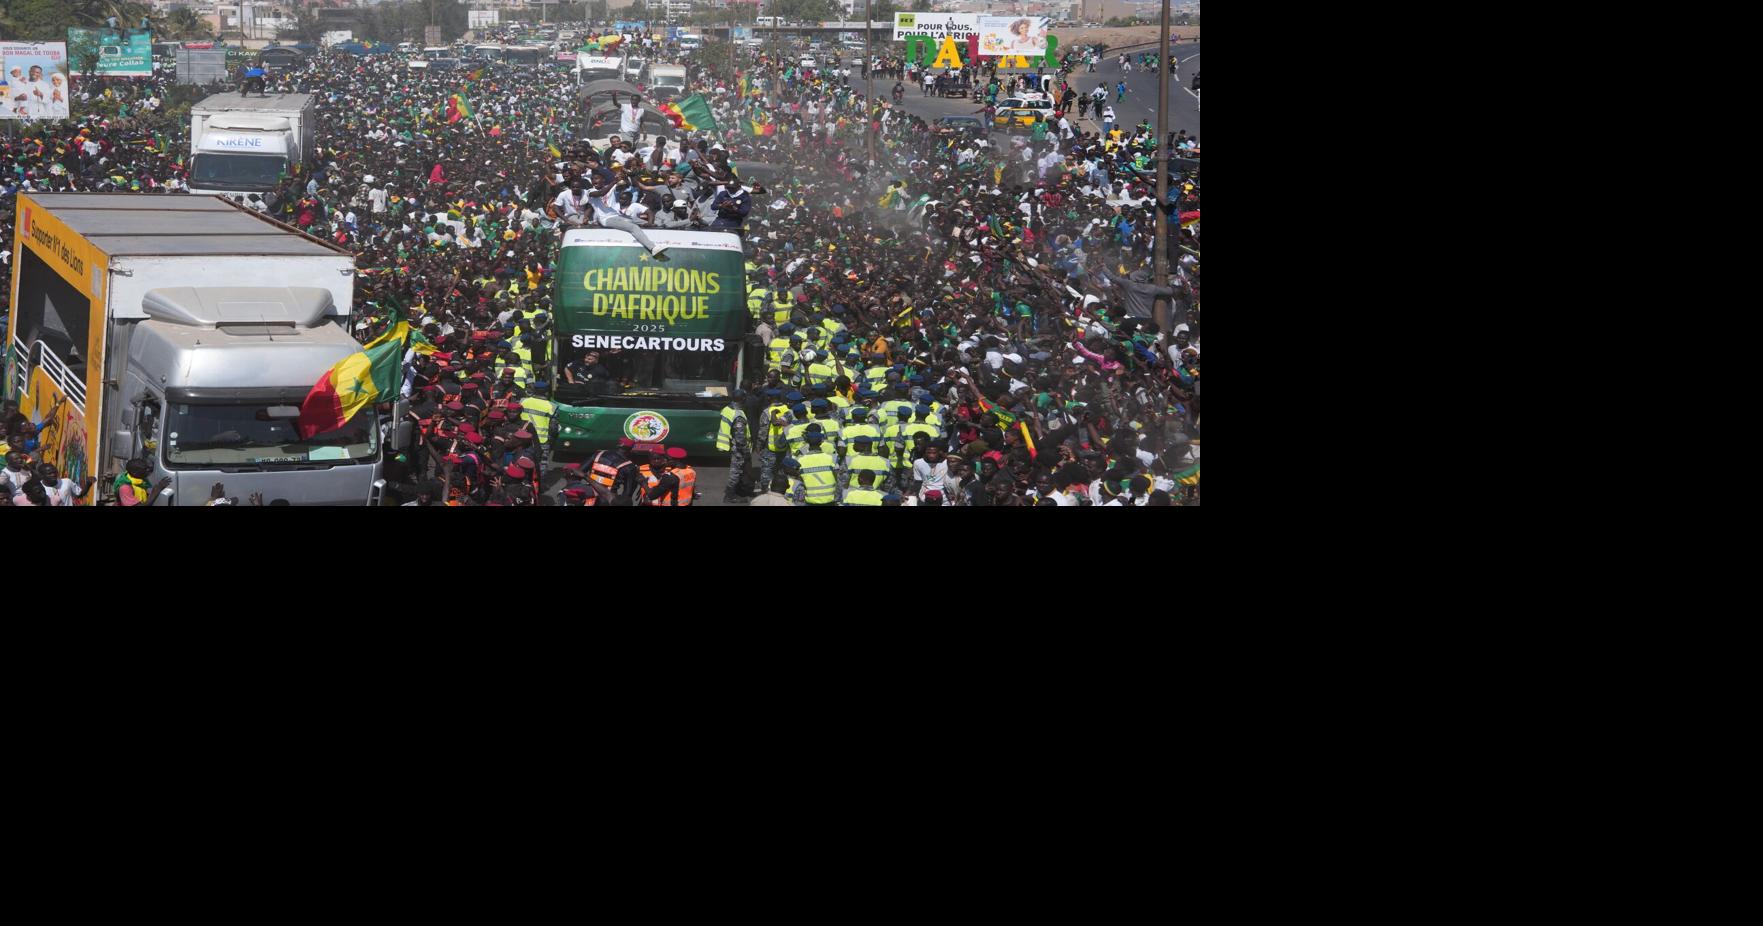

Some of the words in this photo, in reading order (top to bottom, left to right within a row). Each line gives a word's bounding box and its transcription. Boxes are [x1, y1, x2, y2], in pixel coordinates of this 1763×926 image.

[917, 23, 943, 31] POUR
[945, 23, 973, 31] VOUS,
[31, 219, 53, 250] Supporter
[61, 241, 70, 265] des
[69, 247, 84, 277] Lions
[583, 266, 720, 294] CHAMPIONS
[592, 293, 710, 326] D'AFRIQUE
[632, 324, 665, 332] 2025
[571, 334, 725, 352] SENECARTOURS
